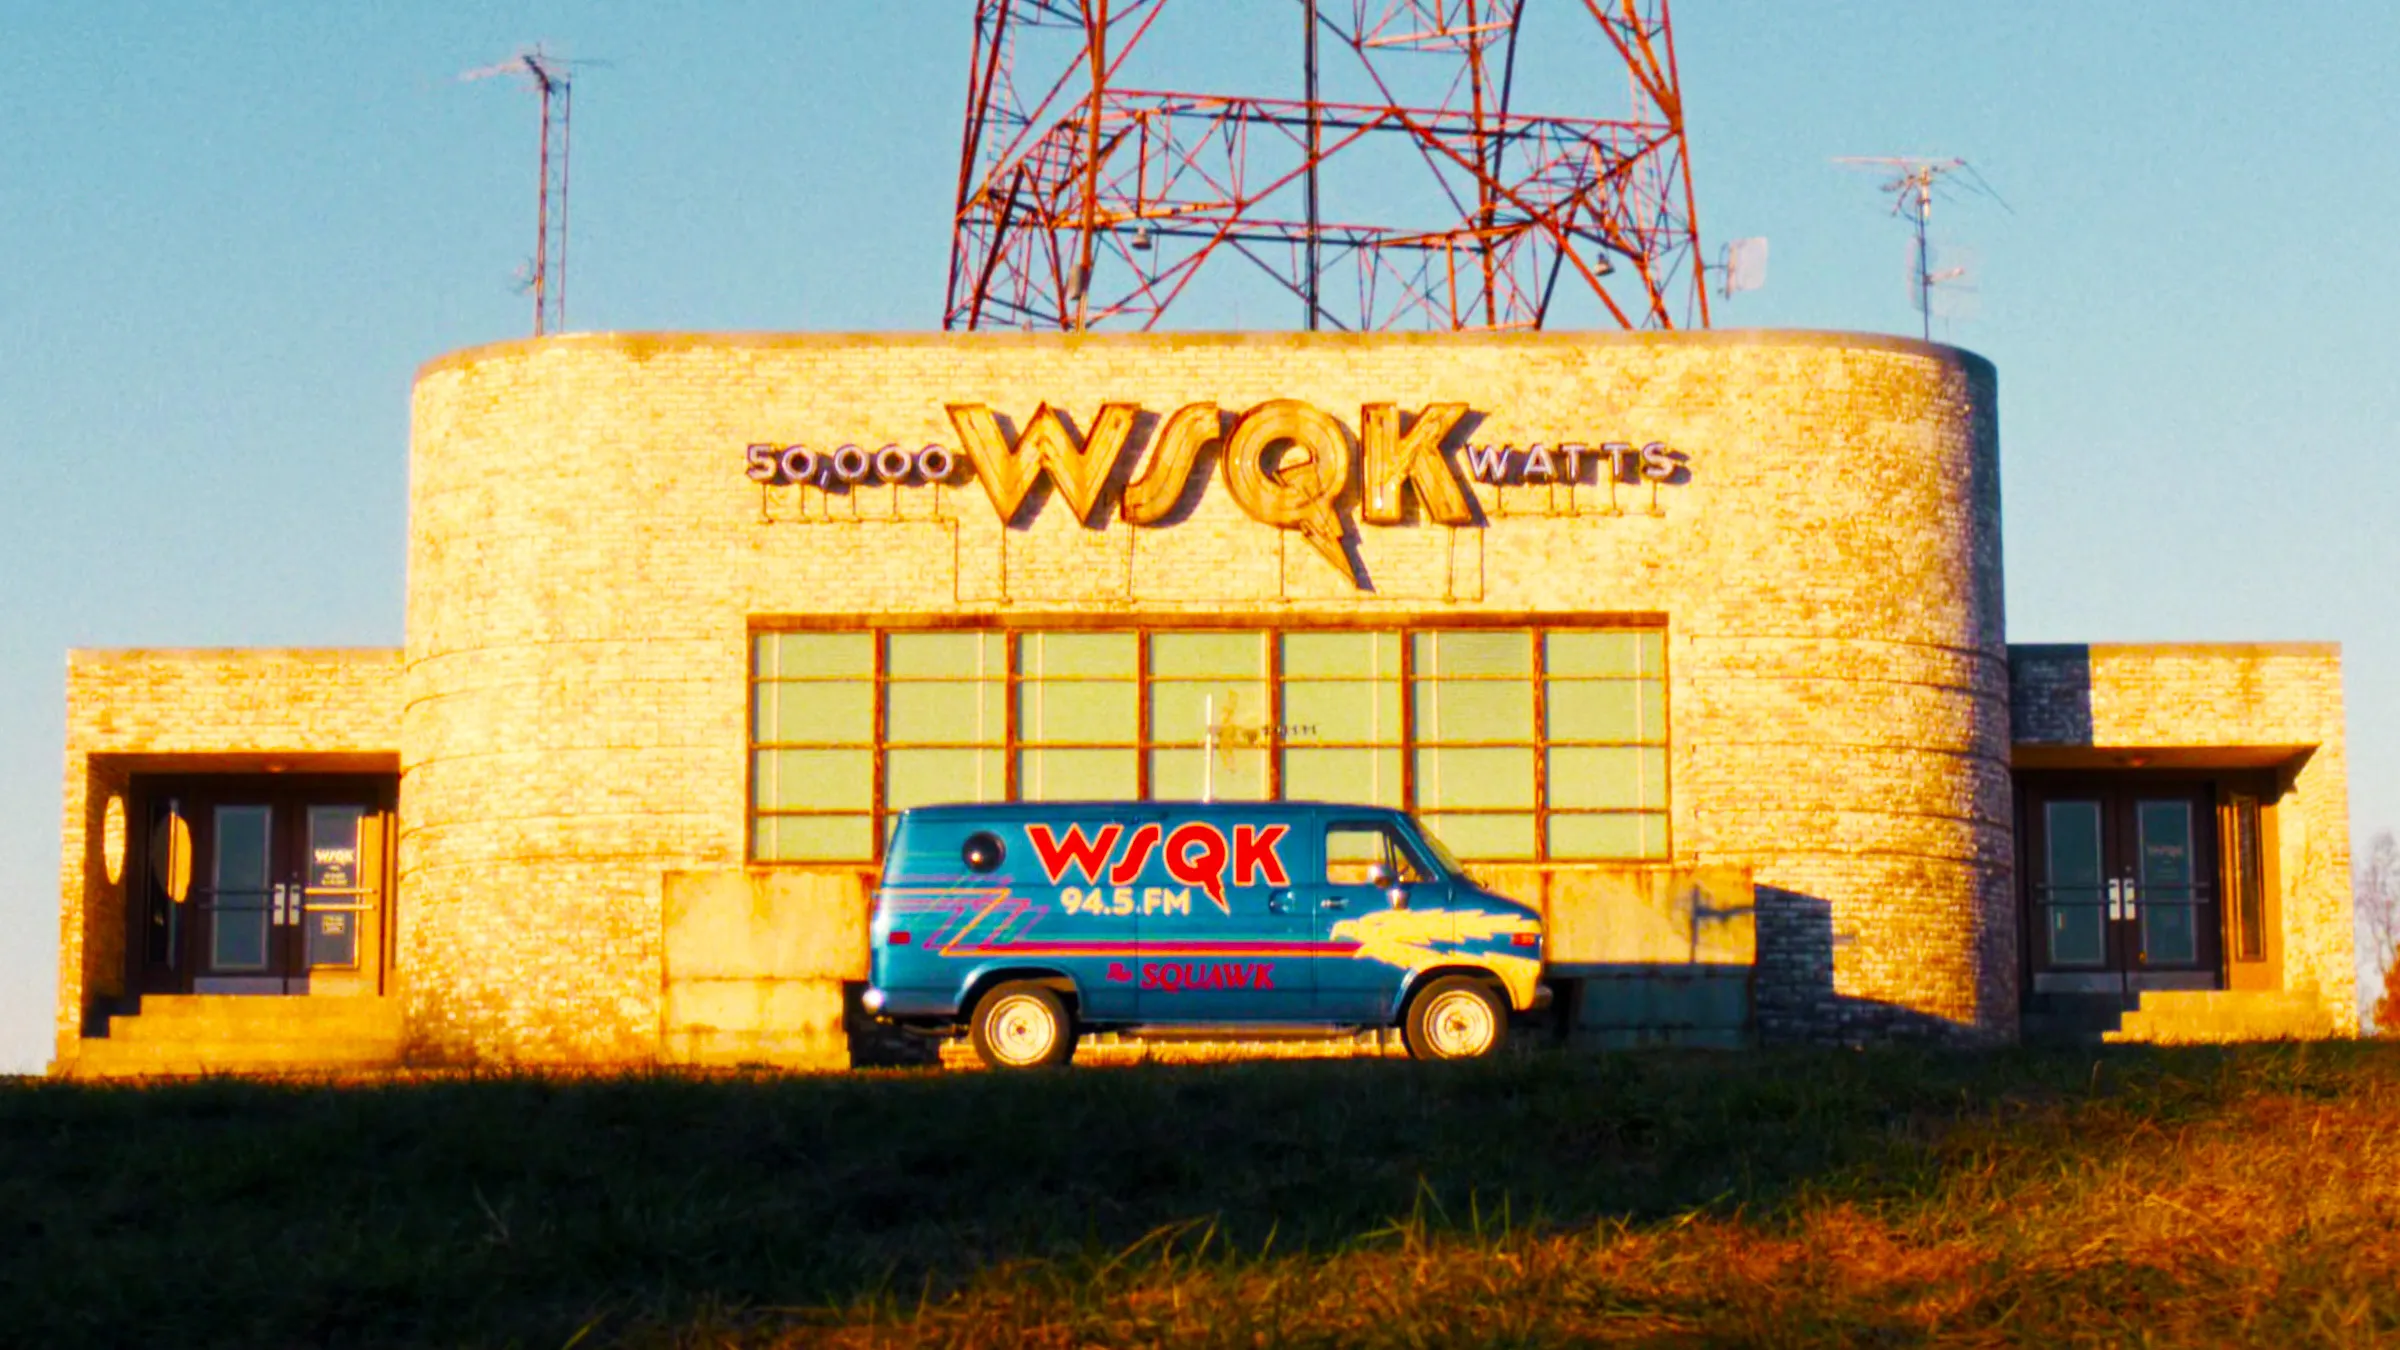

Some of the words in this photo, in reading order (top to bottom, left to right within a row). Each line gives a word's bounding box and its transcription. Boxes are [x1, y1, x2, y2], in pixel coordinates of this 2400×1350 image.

[746, 443, 953, 487] 50,000
[944, 399, 1471, 587] WSQK
[1466, 442, 1674, 482] WATTS
[1024, 821, 1290, 916] WSQK
[1141, 962, 1274, 993] SQUAWK
